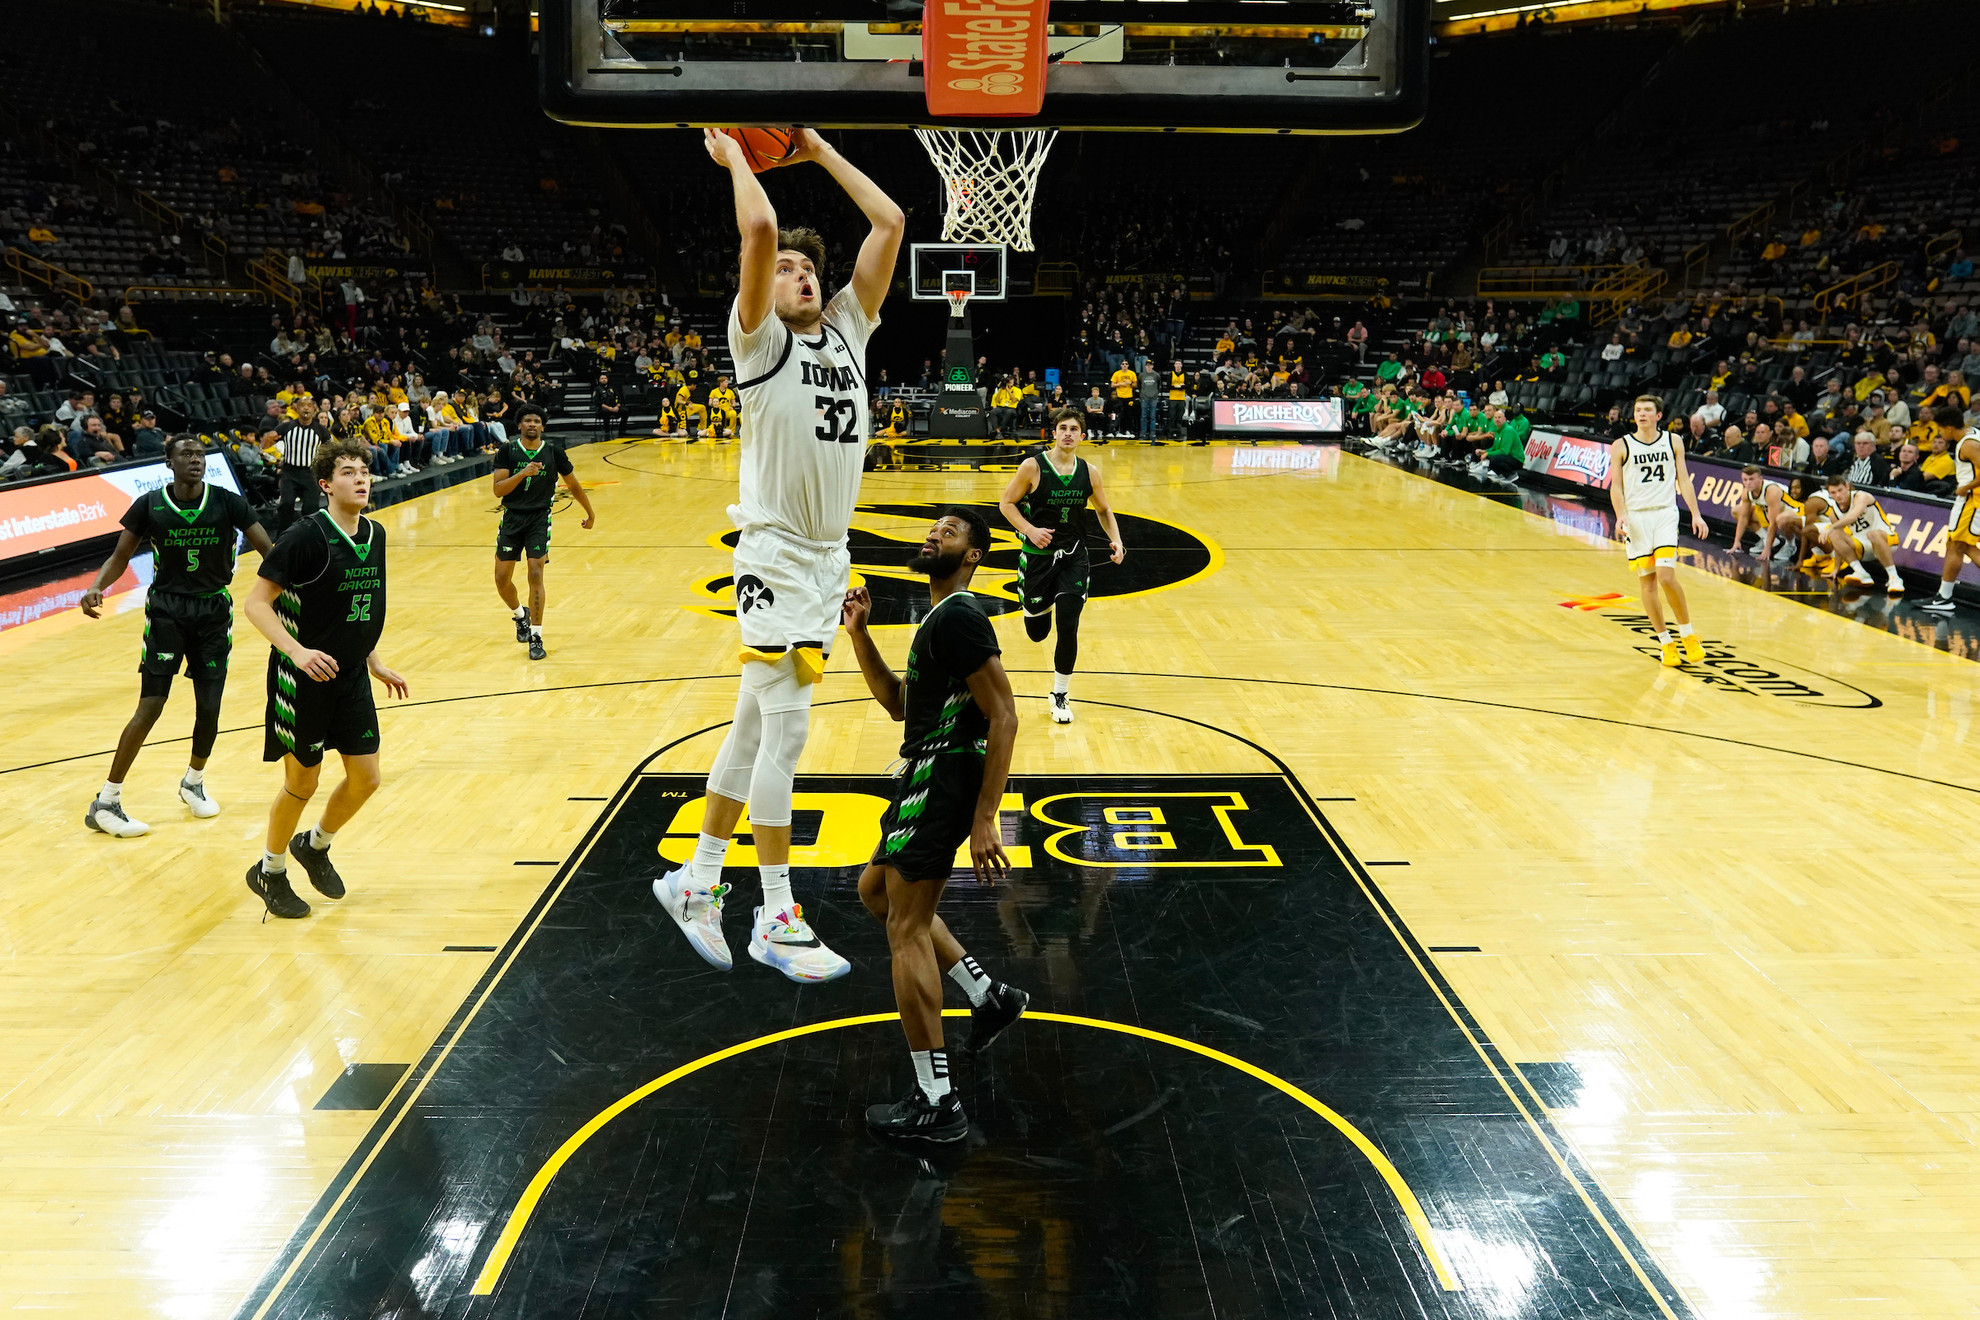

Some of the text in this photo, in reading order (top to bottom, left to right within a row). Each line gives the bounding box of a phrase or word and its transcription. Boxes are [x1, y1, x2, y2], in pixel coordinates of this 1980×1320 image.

[801, 360, 859, 392] IOWA
[815, 395, 859, 443] 32
[1233, 403, 1323, 426] PANCHEROS
[1554, 440, 1612, 481] PANCHEROS
[1633, 452, 1669, 464] IOWA
[134, 475, 164, 493] Proud
[207, 465, 222, 477] the
[1640, 465, 1665, 483] 24
[1047, 498, 1085, 506] DAKOTA
[1051, 489, 1084, 498] NORTH
[1698, 476, 1744, 508] BUR
[10, 507, 80, 537] Interstate
[77, 500, 108, 522] Bank
[1060, 507, 1070, 523] 3
[1851, 516, 1870, 533] 25
[164, 537, 219, 547] DAKOTA
[168, 527, 216, 539] NORTH
[1902, 518, 1949, 559] HA
[186, 549, 200, 572] 5
[346, 593, 372, 621] 52
